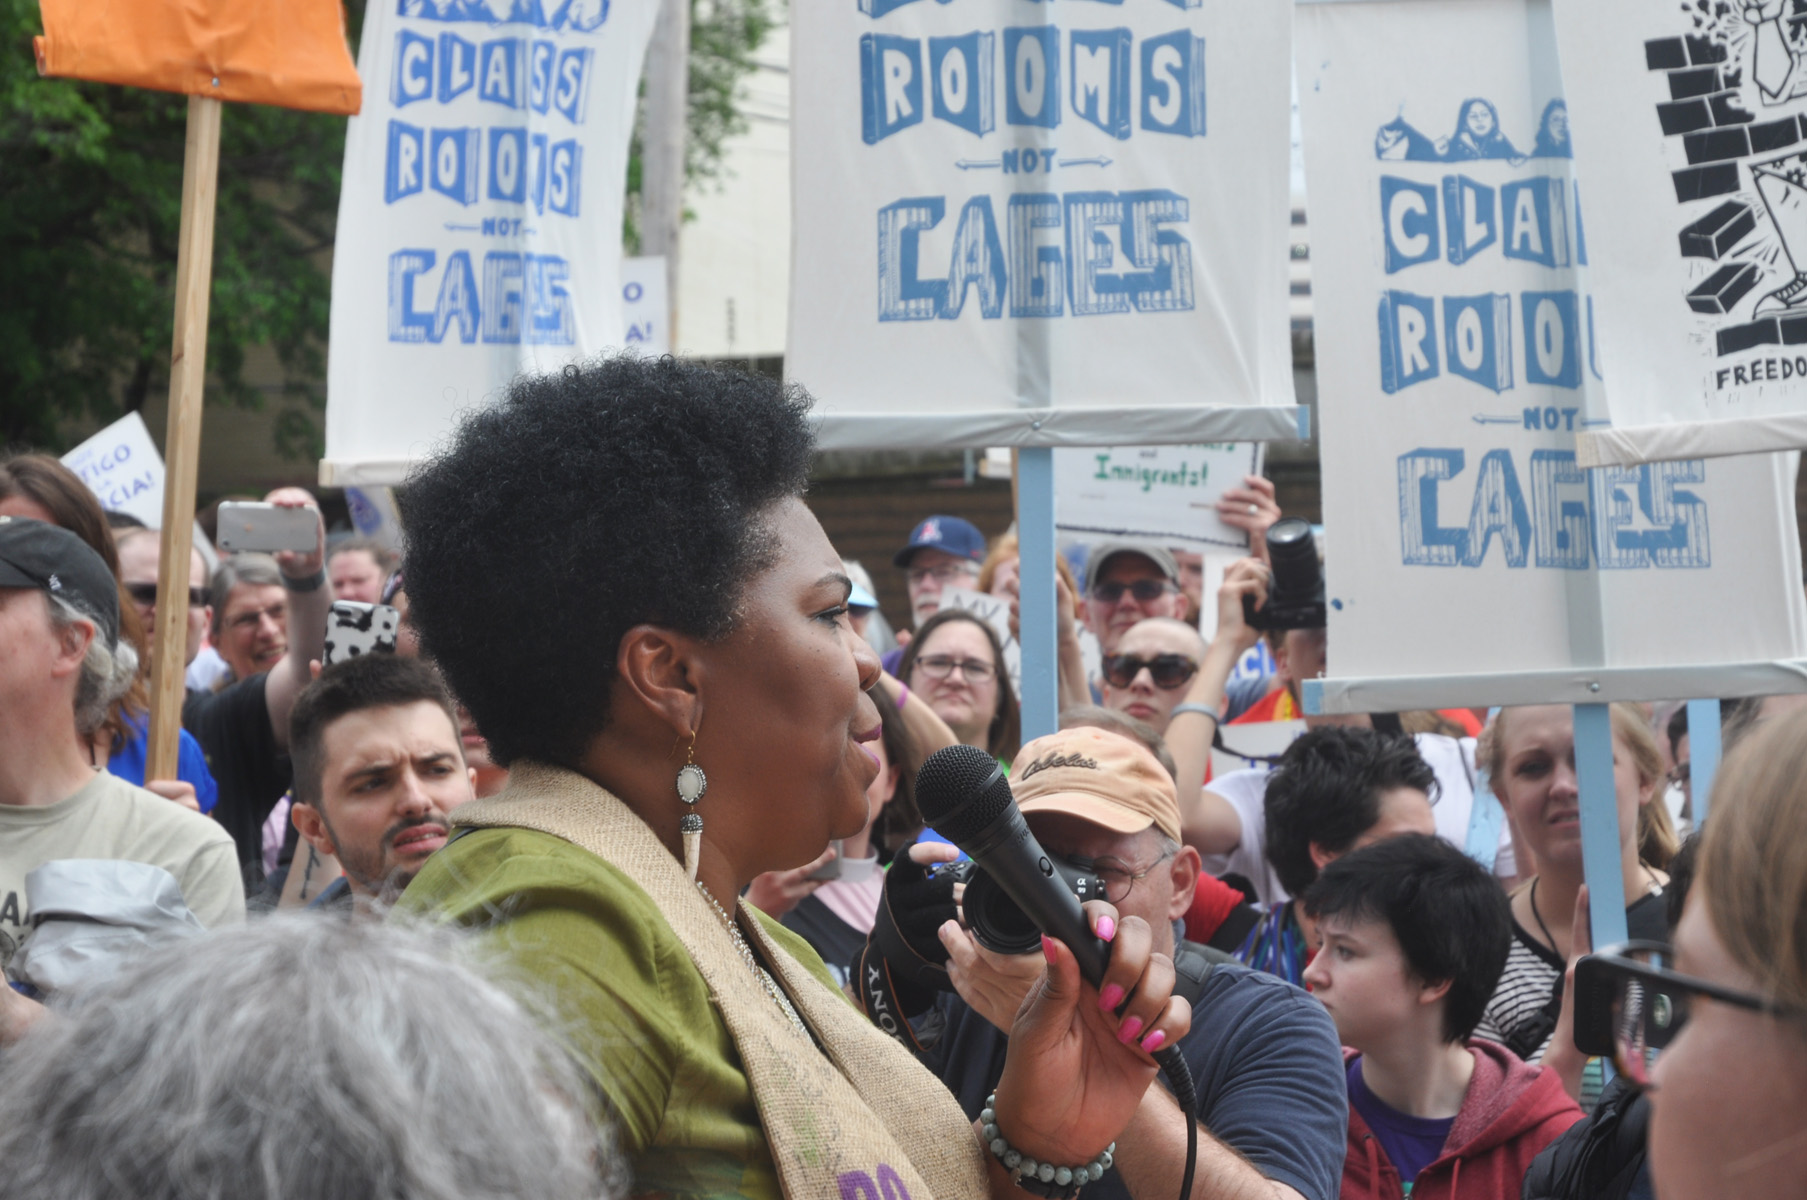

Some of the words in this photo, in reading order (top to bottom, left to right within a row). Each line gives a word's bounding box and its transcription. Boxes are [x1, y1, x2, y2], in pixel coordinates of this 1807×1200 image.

[389, 28, 595, 124] CLASS
[859, 24, 1207, 145] ROOMS
[385, 118, 583, 217] ROOS
[1001, 148, 1057, 174] NOT
[481, 217, 522, 236] NOT
[877, 189, 1195, 322] CAGES
[1379, 174, 1588, 275] CLA
[1377, 290, 1602, 394] ROO
[1715, 355, 1807, 390] FREEDO
[1522, 408, 1579, 431] NOT
[1093, 454, 1208, 492] Immigrants!
[1397, 448, 1711, 570] CAGES
[1021, 751, 1098, 781] Cabela's
[868, 963, 907, 1046] ONY
